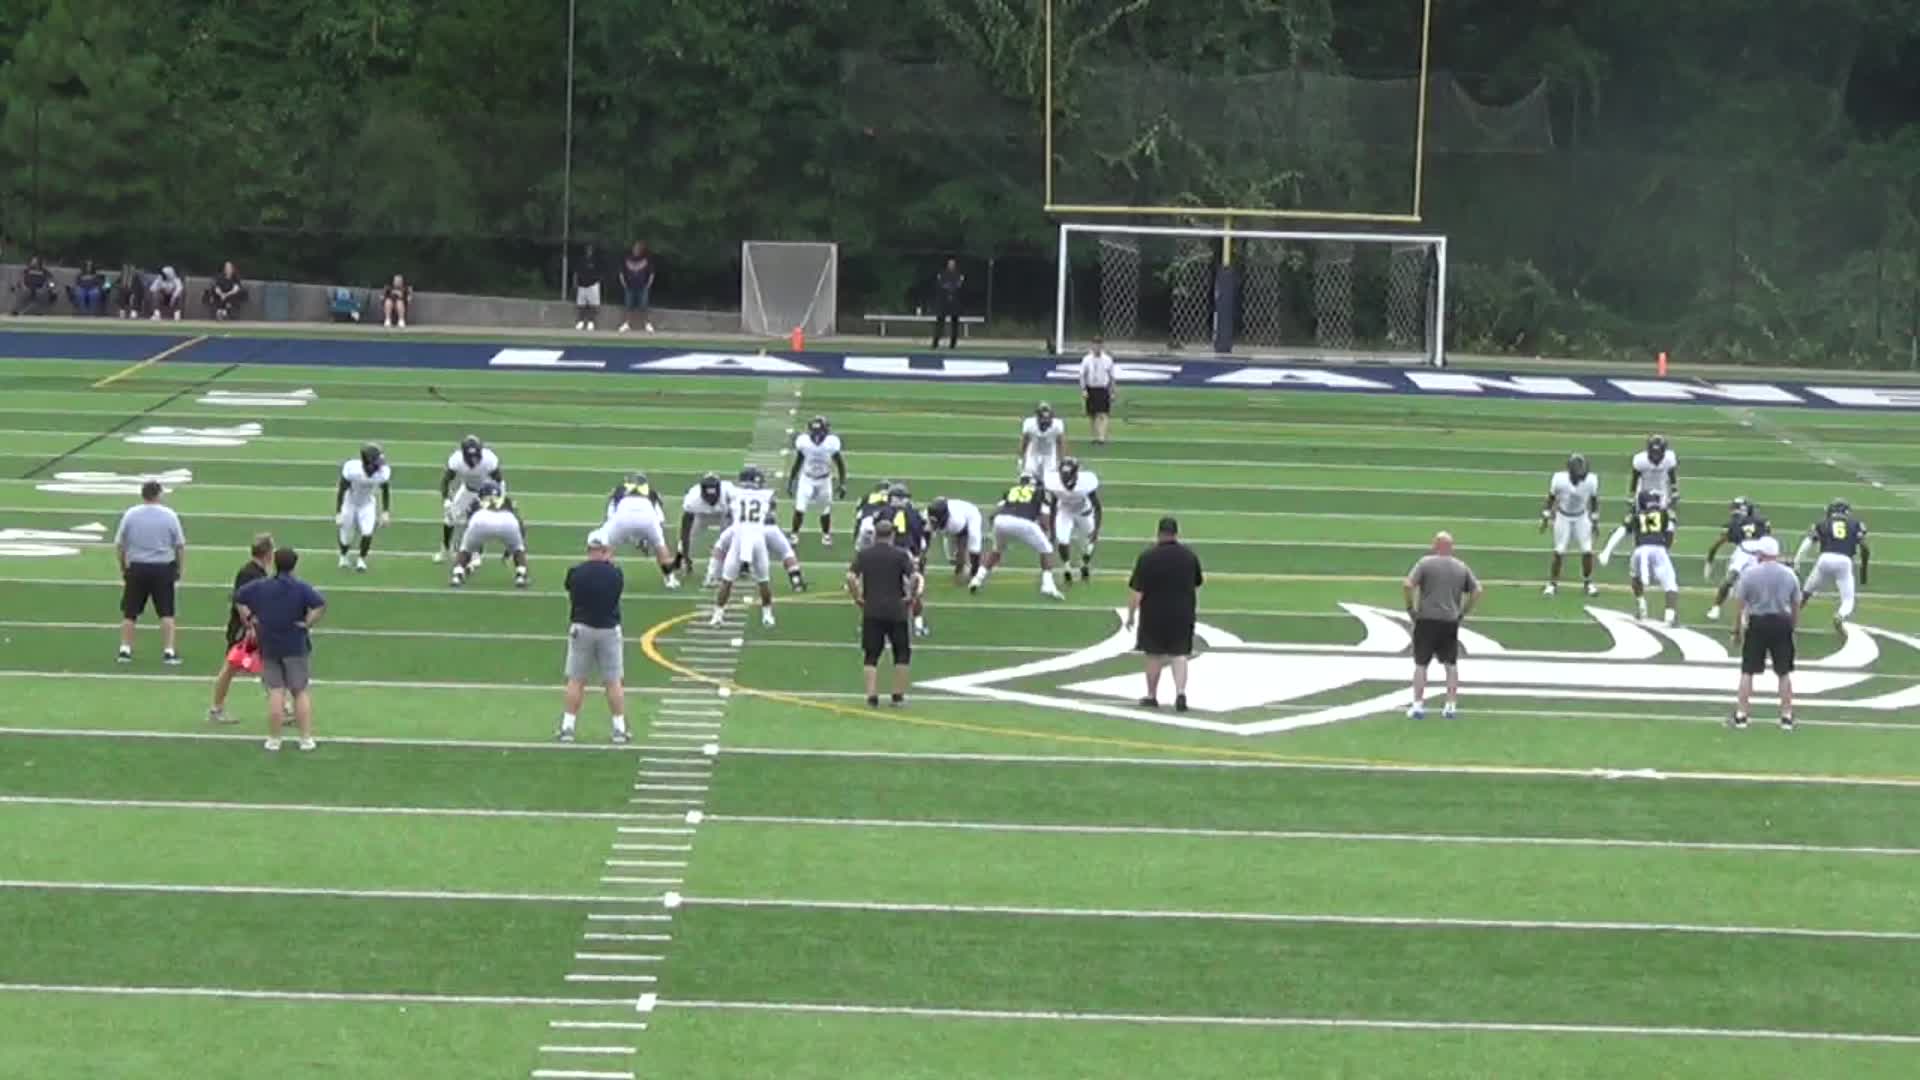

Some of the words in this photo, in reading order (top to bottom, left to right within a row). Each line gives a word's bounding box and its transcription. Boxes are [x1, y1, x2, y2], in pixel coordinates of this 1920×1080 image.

[489, 347, 1920, 407] LAUSANNE
[738, 499, 761, 523] 12
[893, 510, 907, 534] 4
[1638, 510, 1662, 534] 13
[1832, 520, 1847, 539] 6
